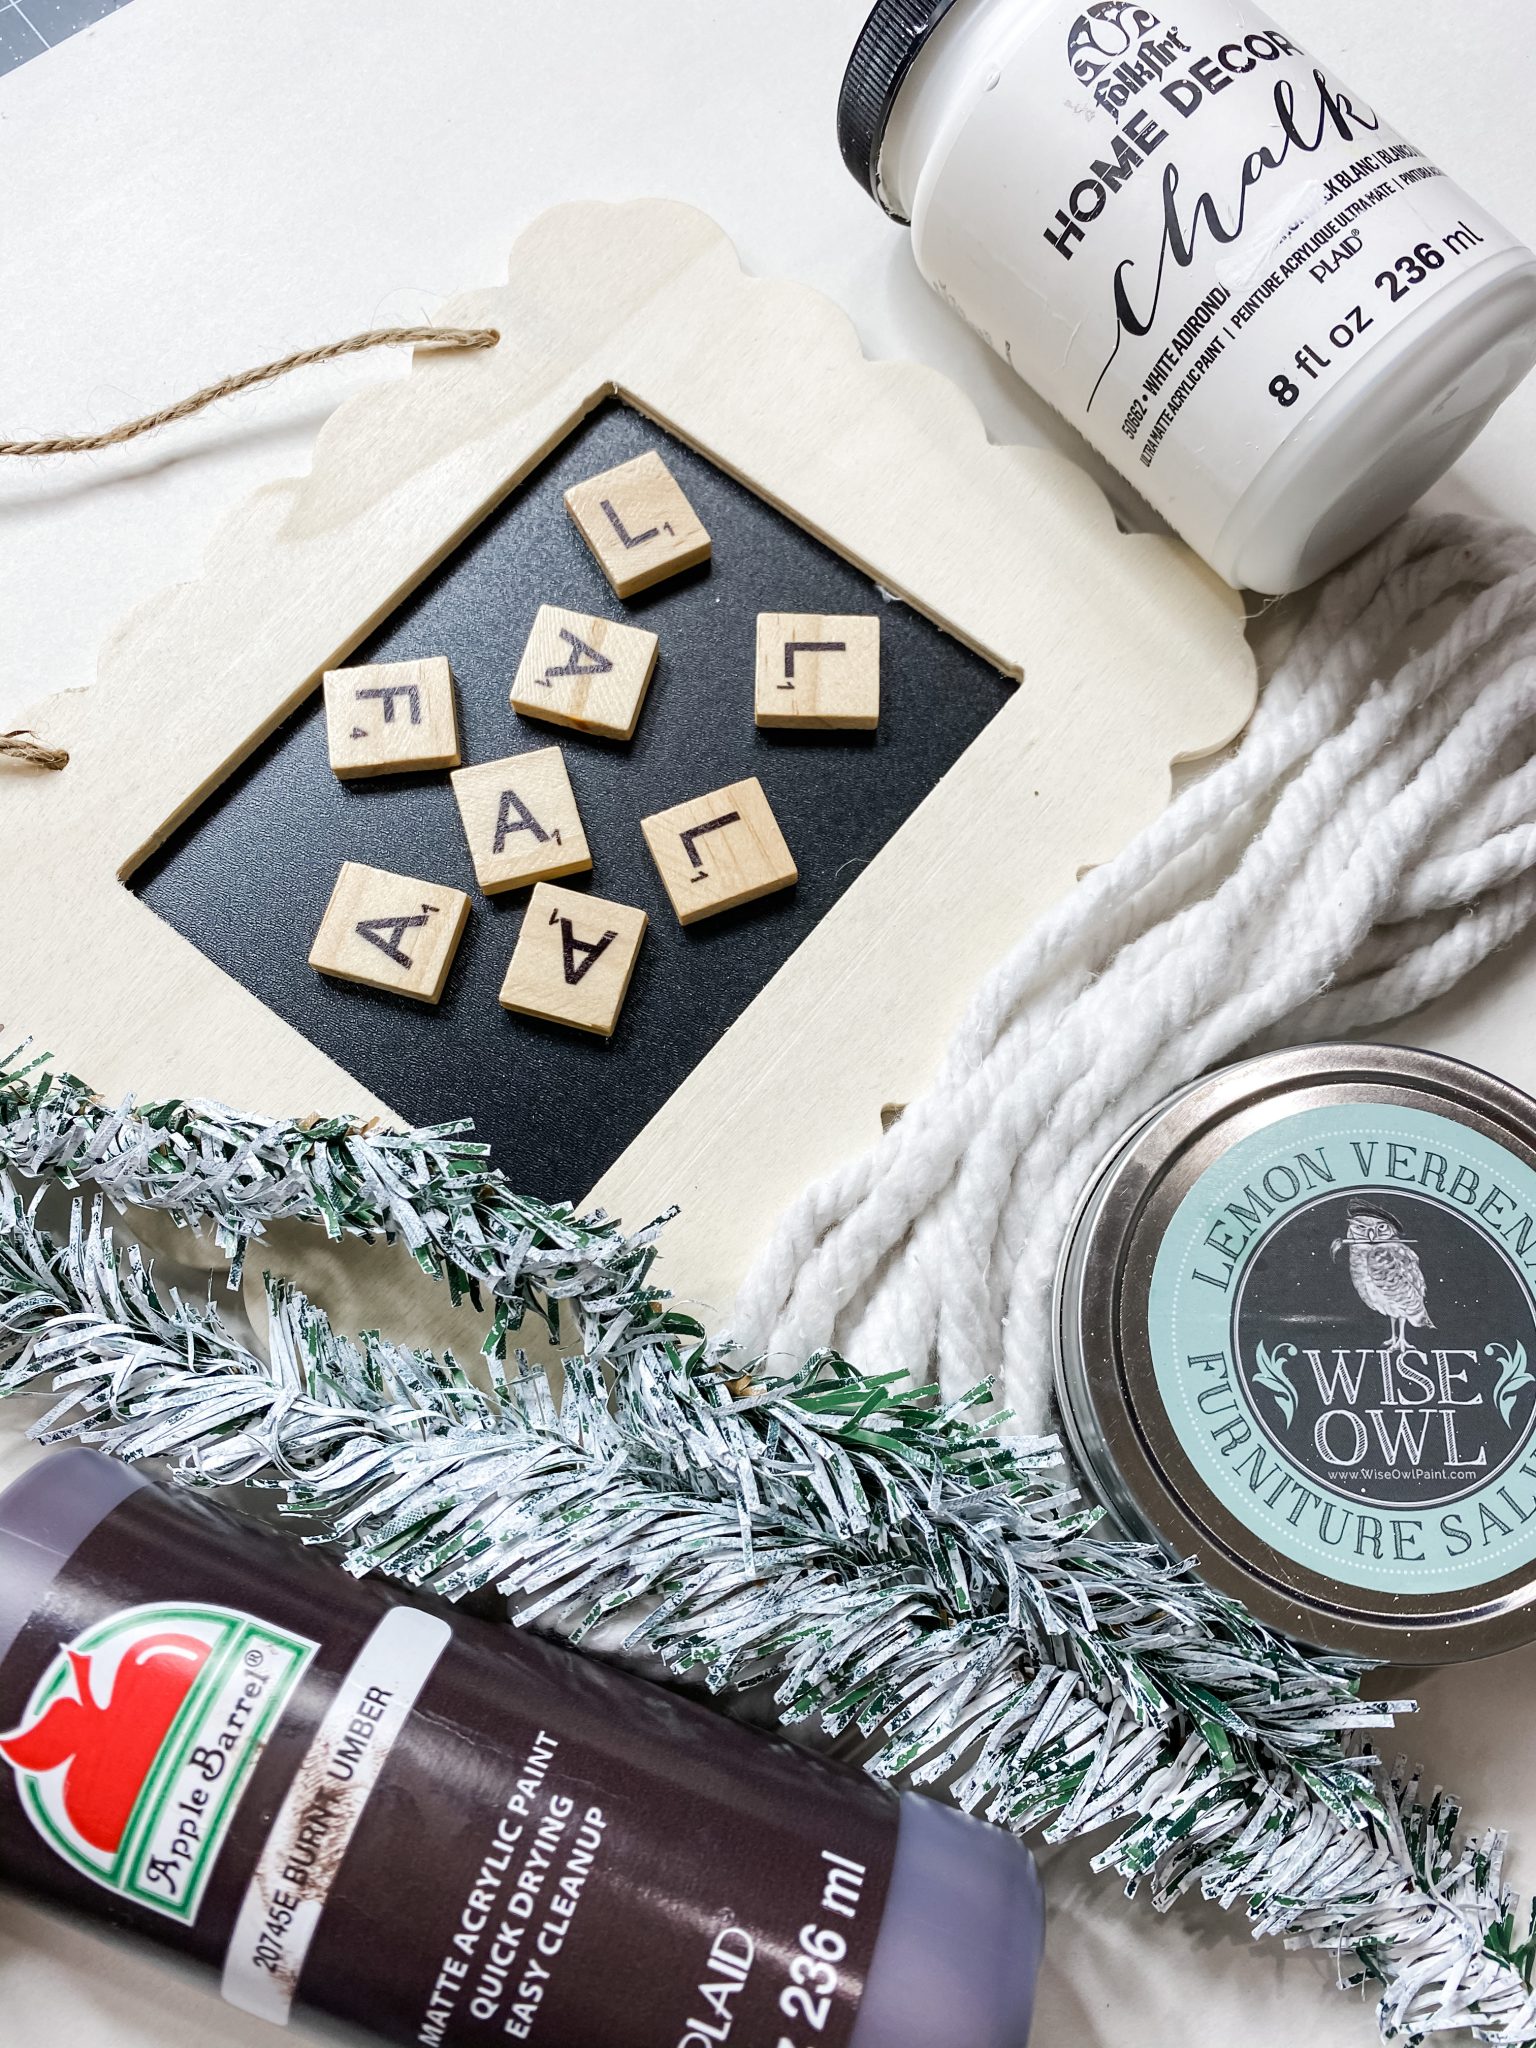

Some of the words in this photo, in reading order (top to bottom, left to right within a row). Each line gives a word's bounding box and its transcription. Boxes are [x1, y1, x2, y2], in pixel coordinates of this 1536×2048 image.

[1043, 109, 1169, 260] HOME
[1160, 31, 1304, 118] DECOR
[1333, 156, 1380, 190] BLANC
[1087, 69, 1379, 412] chalk
[1150, 408, 1174, 441] MATTE
[1168, 368, 1201, 416] ACRYLIC
[1194, 335, 1226, 375] PAINT
[1230, 271, 1285, 330] PEINTURE
[1279, 220, 1341, 279] ACRYLIQUE
[1334, 197, 1373, 229] ULTRA
[1268, 374, 1300, 407] 8
[1295, 344, 1331, 379] fl
[1329, 305, 1374, 349] oz
[1375, 242, 1445, 303] 236
[1442, 220, 1484, 255] ml
[1122, 399, 1148, 440] 50662
[1143, 348, 1180, 396] WHITE
[1192, 1147, 1332, 1294] LEMON
[1188, 1352, 1426, 1562] FURNITURE
[1302, 1350, 1483, 1405] WISE
[1314, 1409, 1487, 1466] OWL
[1328, 1469, 1477, 1480] www.WiseOwlPaint.com
[146, 1787, 209, 1895] Apple
[253, 1889, 298, 1973] 20745E
[283, 1786, 340, 1887] BURNT
[327, 1685, 393, 1783] UMBER
[417, 1956, 470, 2048] MATTE
[453, 1818, 523, 1956] ACRYLIC
[507, 1730, 559, 1816] PAINT
[469, 1922, 525, 2020] QUICK
[507, 1794, 574, 1920] DRYING
[504, 1958, 550, 2040] EASY
[537, 1806, 607, 1956] CLEANUP
[779, 1923, 848, 2031] 236
[821, 1850, 866, 1918] ml
